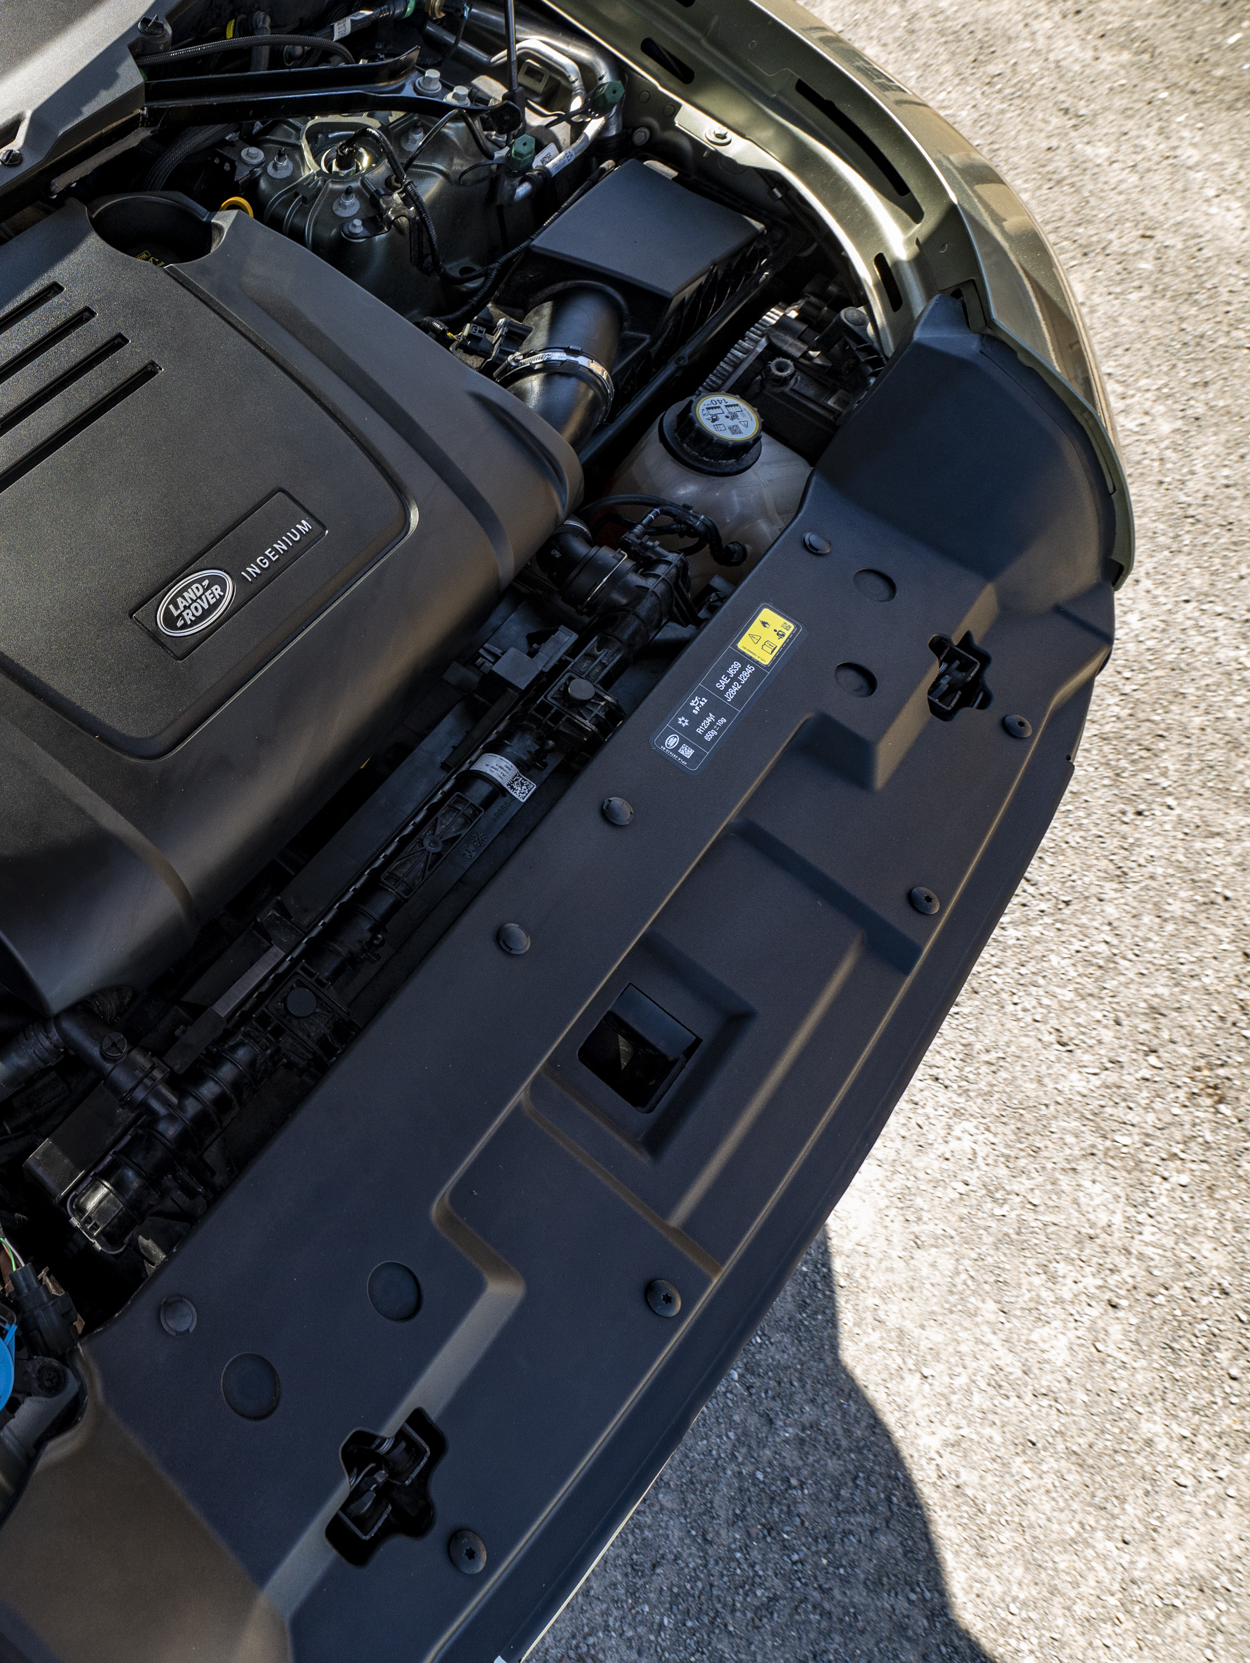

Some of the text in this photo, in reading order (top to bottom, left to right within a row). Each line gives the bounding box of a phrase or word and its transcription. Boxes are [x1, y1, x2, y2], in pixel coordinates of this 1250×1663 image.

[241, 519, 313, 582] INGENIUM
[169, 582, 204, 617] LAND
[184, 584, 224, 625] ROVER
[716, 661, 742, 691] SAE J639
[724, 682, 742, 702] J2842
[739, 664, 756, 684] J2845
[696, 712, 716, 735] R1234yf
